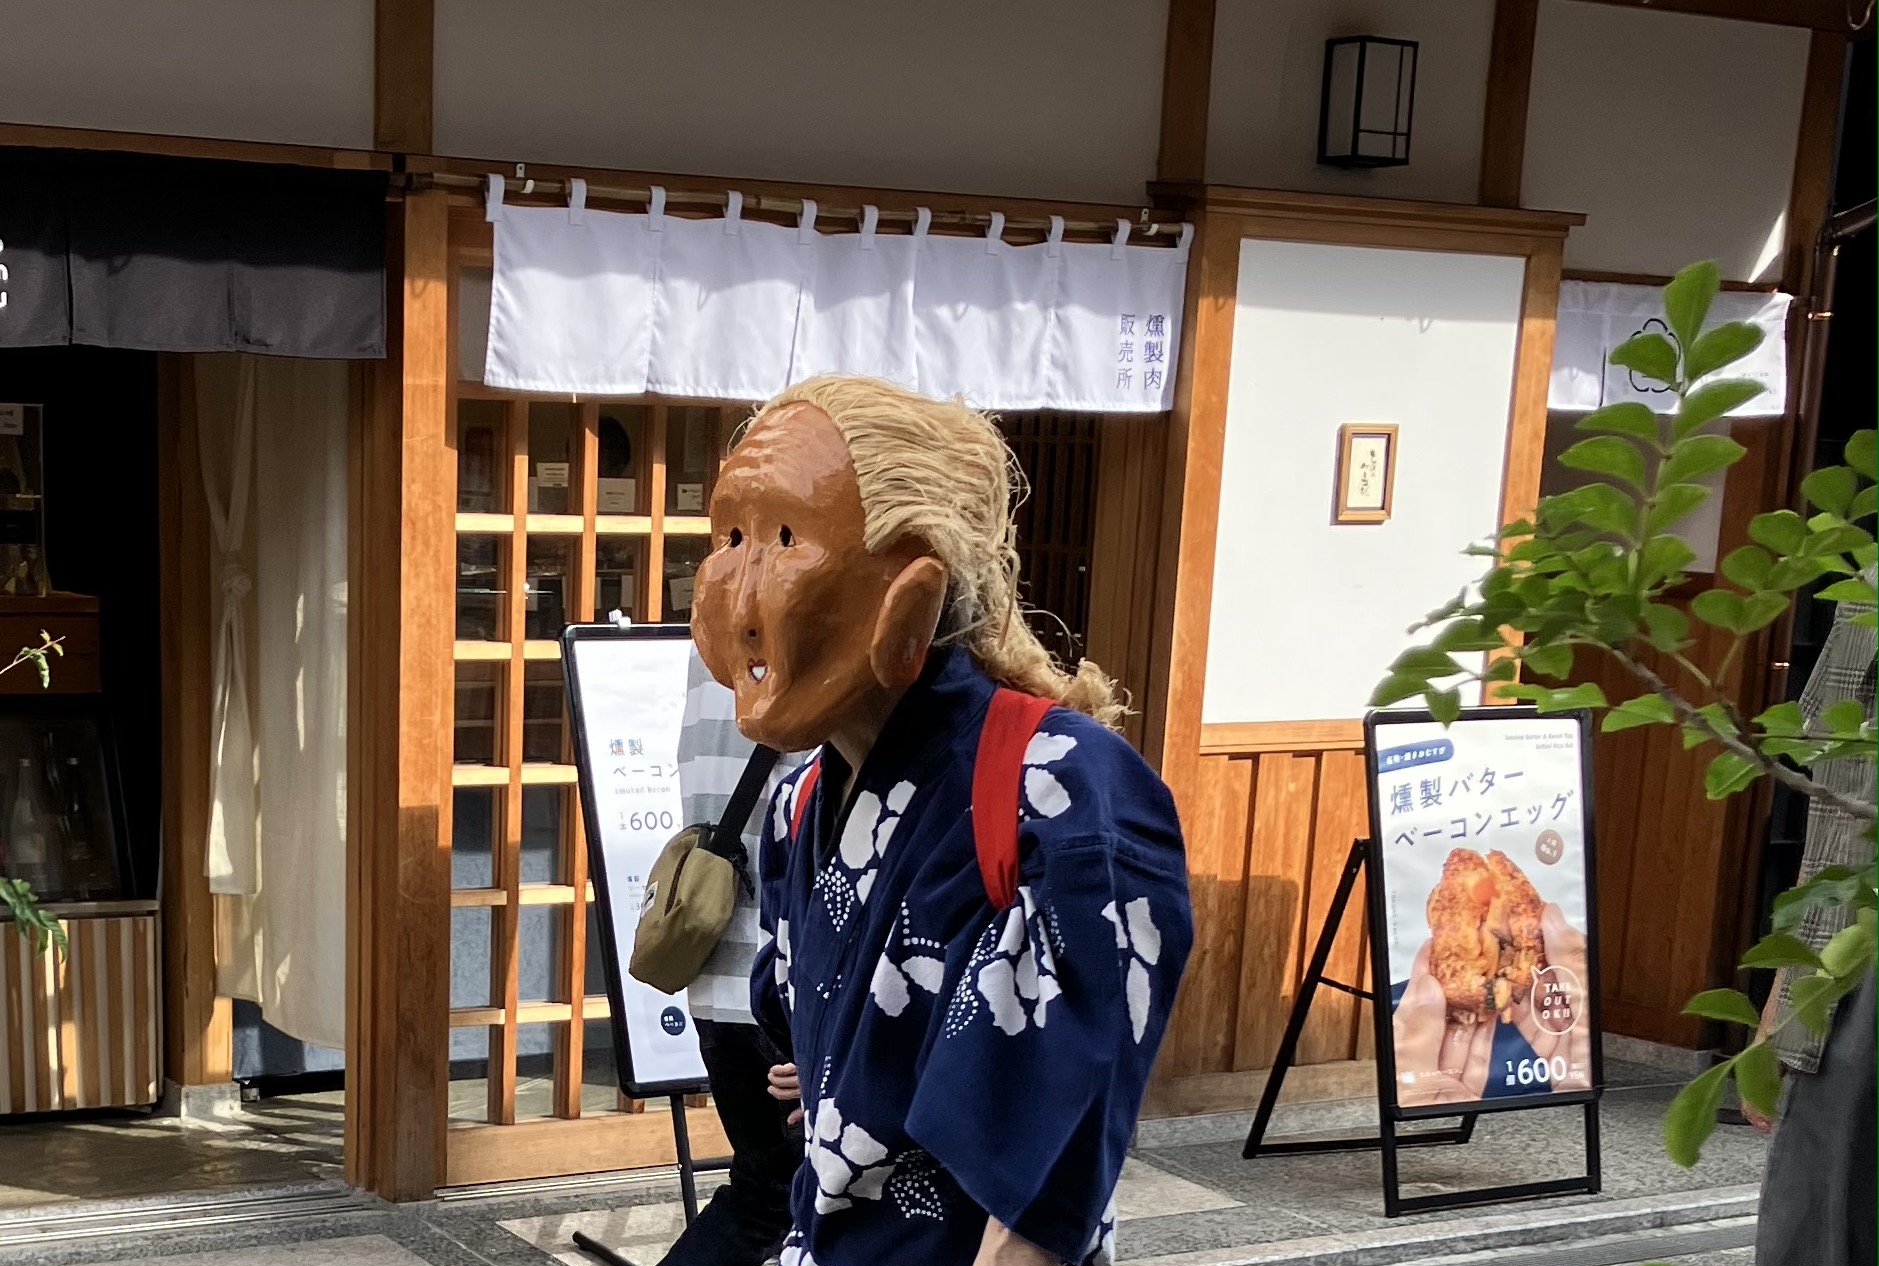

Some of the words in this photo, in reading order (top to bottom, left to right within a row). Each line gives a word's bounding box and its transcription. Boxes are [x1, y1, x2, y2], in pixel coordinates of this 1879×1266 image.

[1116, 313, 1136, 391] 販売所
[1143, 313, 1165, 391] 燻製肉
[613, 763, 679, 777] ベーコン
[1390, 766, 1525, 815] 燻製バター
[630, 811, 673, 831] 600
[1395, 789, 1575, 846] ベーコンエッグ
[1544, 982, 1571, 993] TAKE
[1544, 995, 1571, 1006] OUT
[1517, 1056, 1567, 1085] 600
